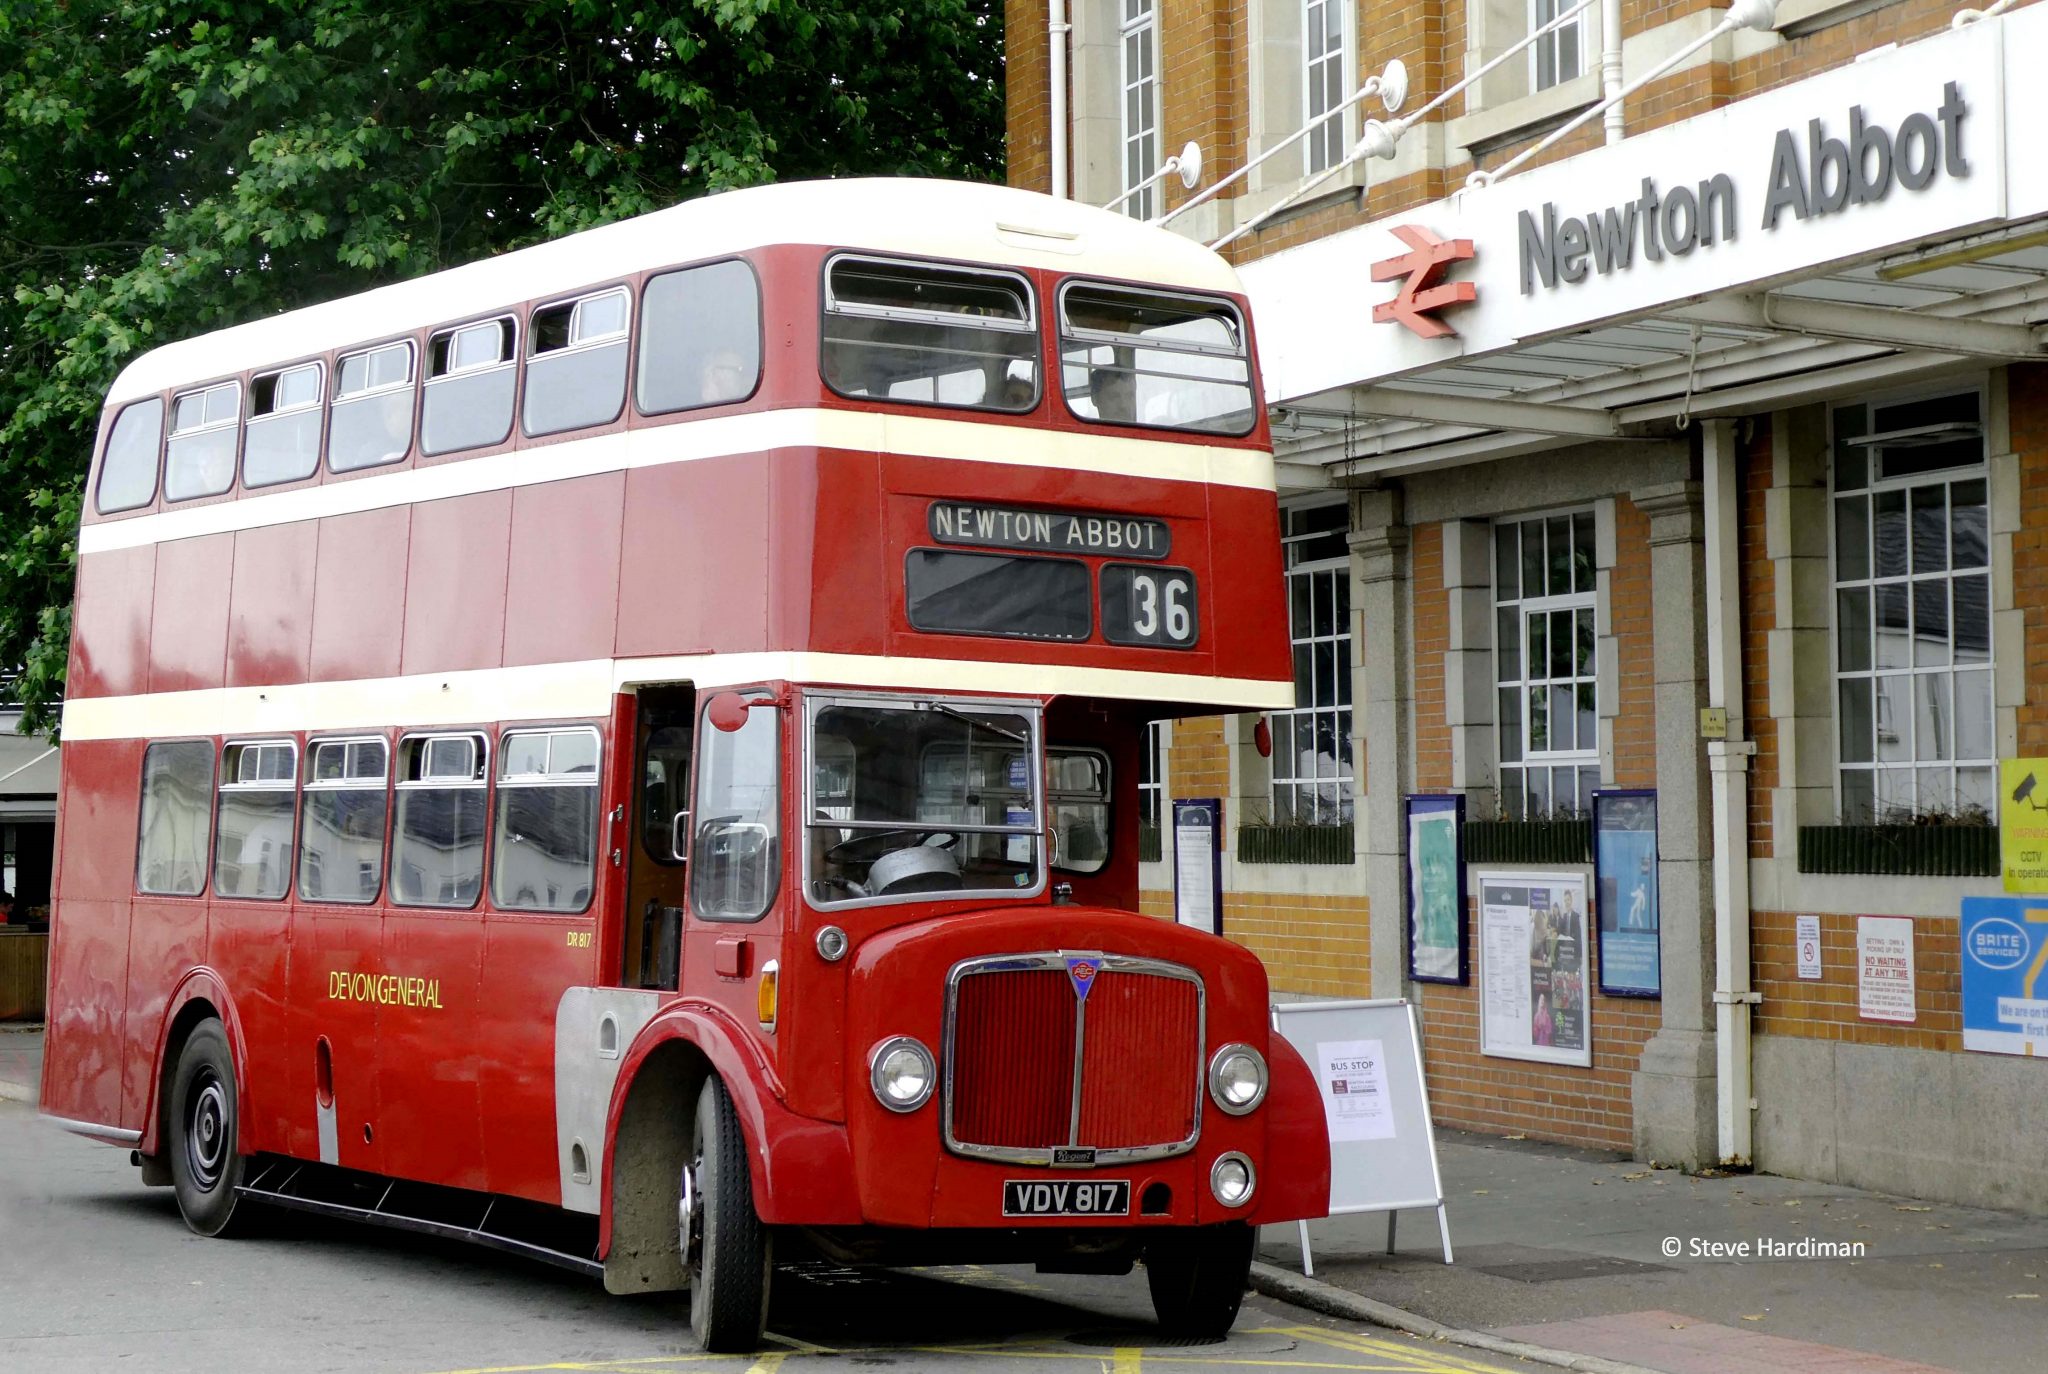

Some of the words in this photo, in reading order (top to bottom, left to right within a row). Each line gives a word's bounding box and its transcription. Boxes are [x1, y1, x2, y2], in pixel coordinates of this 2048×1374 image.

[1517, 173, 1735, 295] Newton
[1762, 80, 1969, 230] Abbot
[935, 506, 1051, 543] NEWTON
[1066, 516, 1158, 550] ABBOT
[1133, 575, 1191, 641] 36
[2020, 851, 2041, 862] CCTV
[567, 931, 578, 947] DR
[579, 933, 592, 948] 817
[1976, 933, 2020, 948] BRITE
[1866, 945, 1885, 953] PICKING
[1886, 946, 1892, 954] UP
[1976, 947, 2020, 957] SERVICES
[1865, 956, 1875, 966] NO
[1877, 957, 1907, 967] WAITING
[1073, 965, 1094, 976] AEC
[1864, 968, 1873, 977] AT
[1875, 969, 1889, 978] ANY
[1892, 970, 1909, 979] TIME
[2000, 1003, 2013, 1016] We
[2015, 1007, 2028, 1017] are
[2030, 1008, 2041, 1018] on
[2027, 1023, 2044, 1036] first
[1331, 1062, 1348, 1071] BUS
[1351, 1061, 1374, 1070] STOP
[1057, 1150, 1092, 1162] Regent
[1016, 1183, 1069, 1212] VDV
[1075, 1184, 1119, 1212] 817
